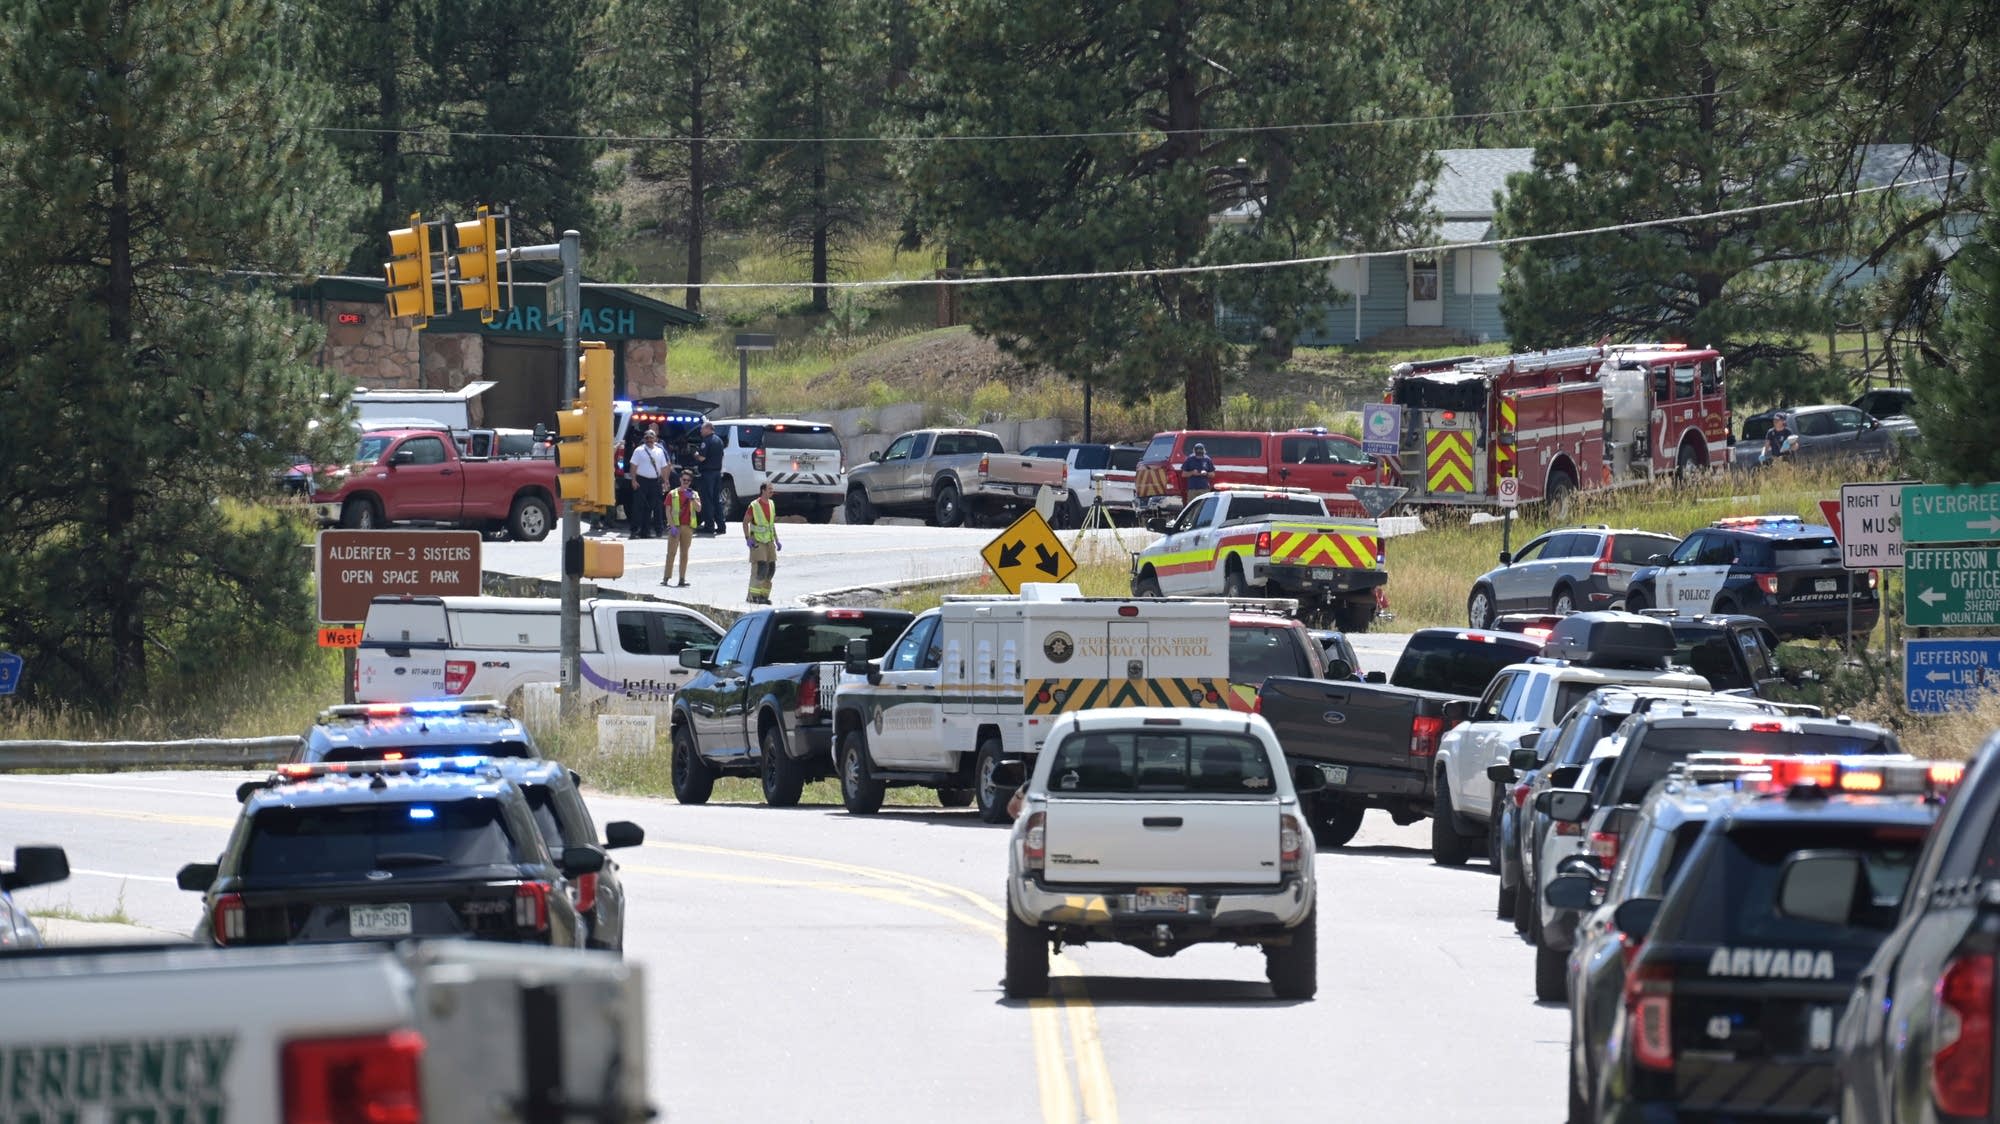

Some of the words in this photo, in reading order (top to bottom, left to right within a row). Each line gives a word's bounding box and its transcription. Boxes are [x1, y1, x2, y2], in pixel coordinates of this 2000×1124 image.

[339, 314, 365, 324] OPE
[557, 307, 635, 335] ASH
[1847, 495, 1879, 508] RIGHT
[1863, 518, 1901, 533] MUS
[330, 547, 391, 560] ALDERFER
[408, 549, 416, 560] 3
[424, 547, 471, 560] SISTERS
[1848, 544, 1878, 557] TURN
[1908, 551, 1987, 569] JEFFERSON
[342, 570, 373, 583] OPEN
[383, 571, 419, 583] SPACE
[431, 571, 460, 583] PARK
[1951, 571, 2000, 589] OFFICE
[1679, 589, 1711, 601] POLICE
[1942, 612, 1994, 623] MOUNTAIN
[326, 632, 357, 644] West
[1079, 637, 1131, 645] JEFFERSON
[1132, 637, 1168, 645] COUNTY
[1172, 637, 1208, 645] SHERIFF
[1078, 646, 1137, 656] ANIMAL
[1141, 646, 1213, 656] CONTROL
[1913, 651, 1988, 665] JEFFERSON
[1707, 947, 1834, 979] ARVADA
[0, 1034, 237, 1100] ERGENCY
